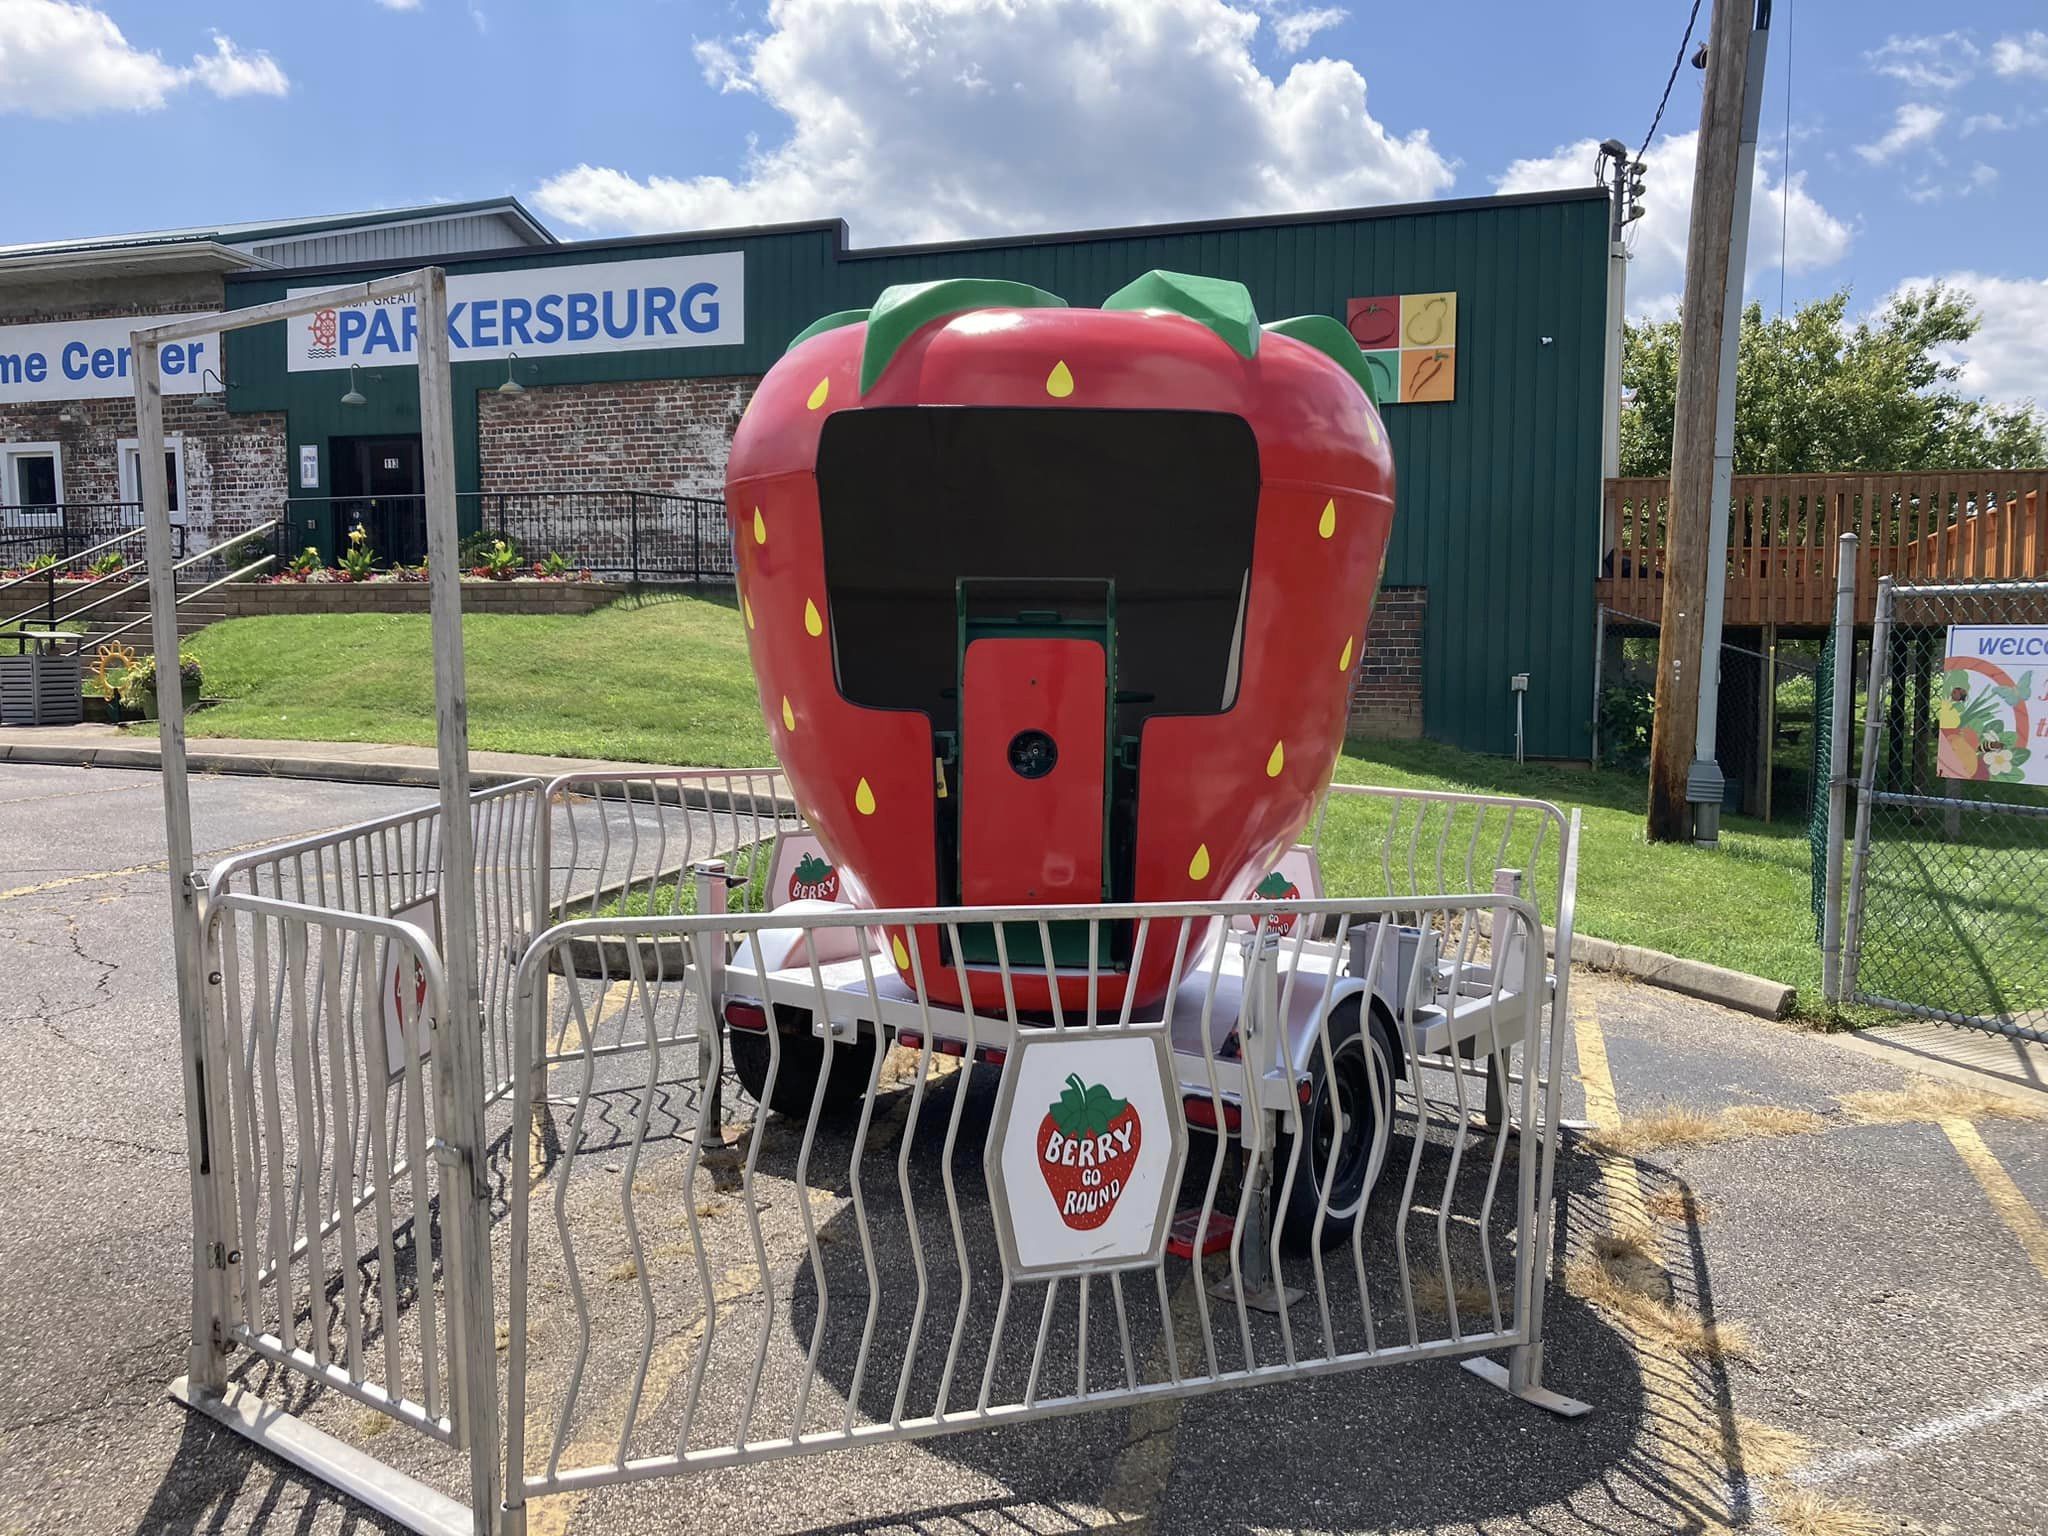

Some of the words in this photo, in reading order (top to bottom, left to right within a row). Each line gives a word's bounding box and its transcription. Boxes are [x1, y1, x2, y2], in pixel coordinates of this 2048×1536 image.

[61, 341, 204, 380] Cener
[792, 877, 835, 899] BERRY
[1044, 1120, 1134, 1168] BERRY
[1082, 1169, 1101, 1186] GO
[1063, 1179, 1121, 1215] ROUND
